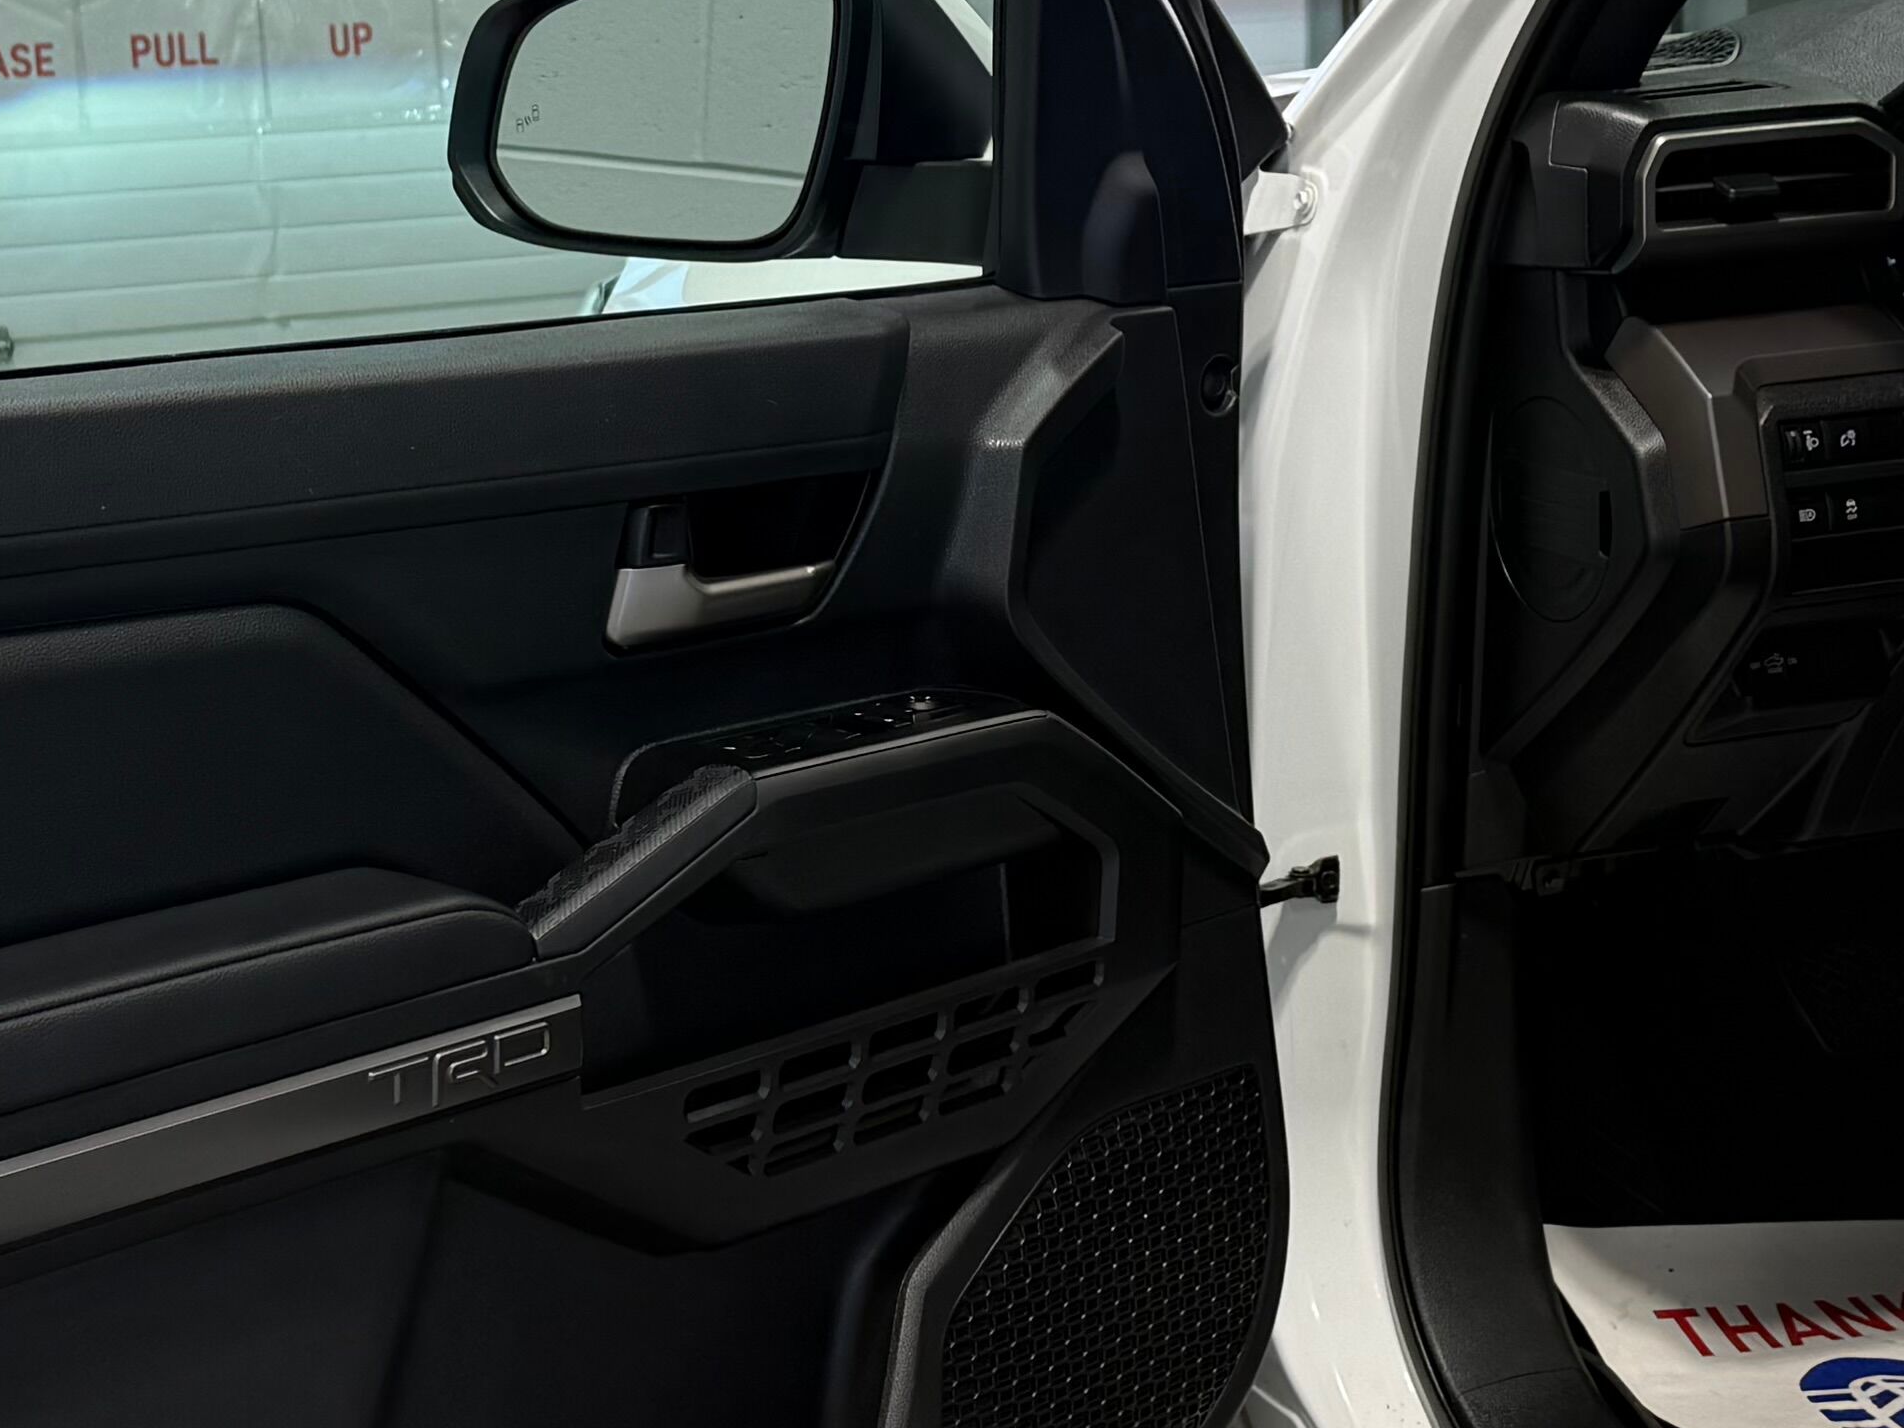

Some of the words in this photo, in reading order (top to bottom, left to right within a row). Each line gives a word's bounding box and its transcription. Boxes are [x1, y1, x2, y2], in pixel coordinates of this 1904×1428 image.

[130, 31, 219, 69] PULL
[329, 22, 373, 58] UP
[367, 1021, 551, 1108] TRD
